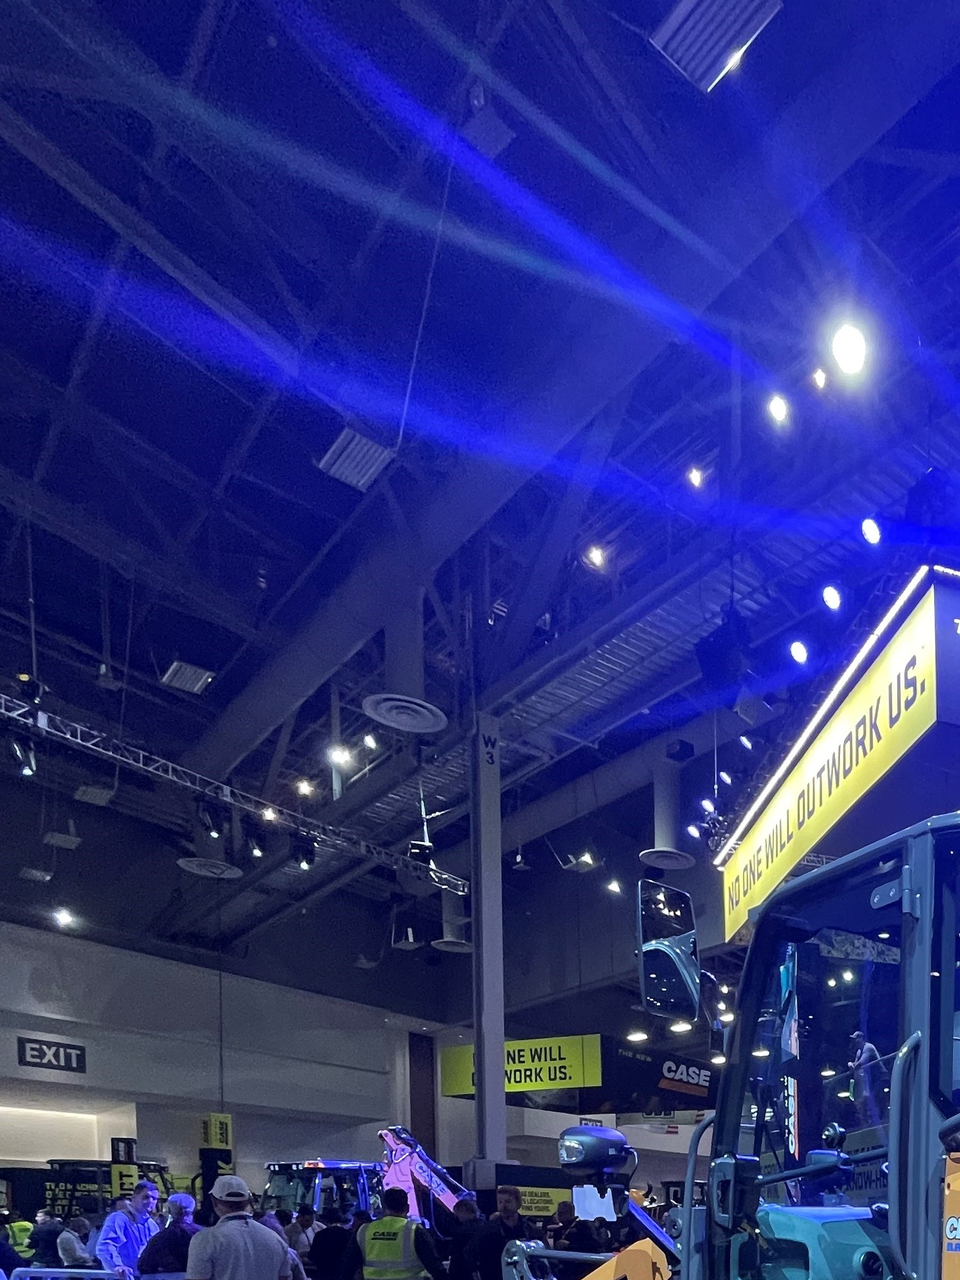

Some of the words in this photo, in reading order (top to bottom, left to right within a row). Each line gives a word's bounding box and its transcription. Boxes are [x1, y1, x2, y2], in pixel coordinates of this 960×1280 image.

[481, 733, 498, 750] W
[485, 751, 496, 766] 3
[728, 876, 741, 916] NO
[742, 858, 763, 898] ONE
[764, 808, 794, 871] WILL
[796, 694, 883, 831] OUTWORK
[887, 654, 927, 730] US.
[25, 1042, 81, 1068] EXIT
[529, 1045, 567, 1063] WILL
[548, 1065, 572, 1082] US.
[662, 1060, 711, 1087] CASE
[415, 1161, 447, 1197] CASE
